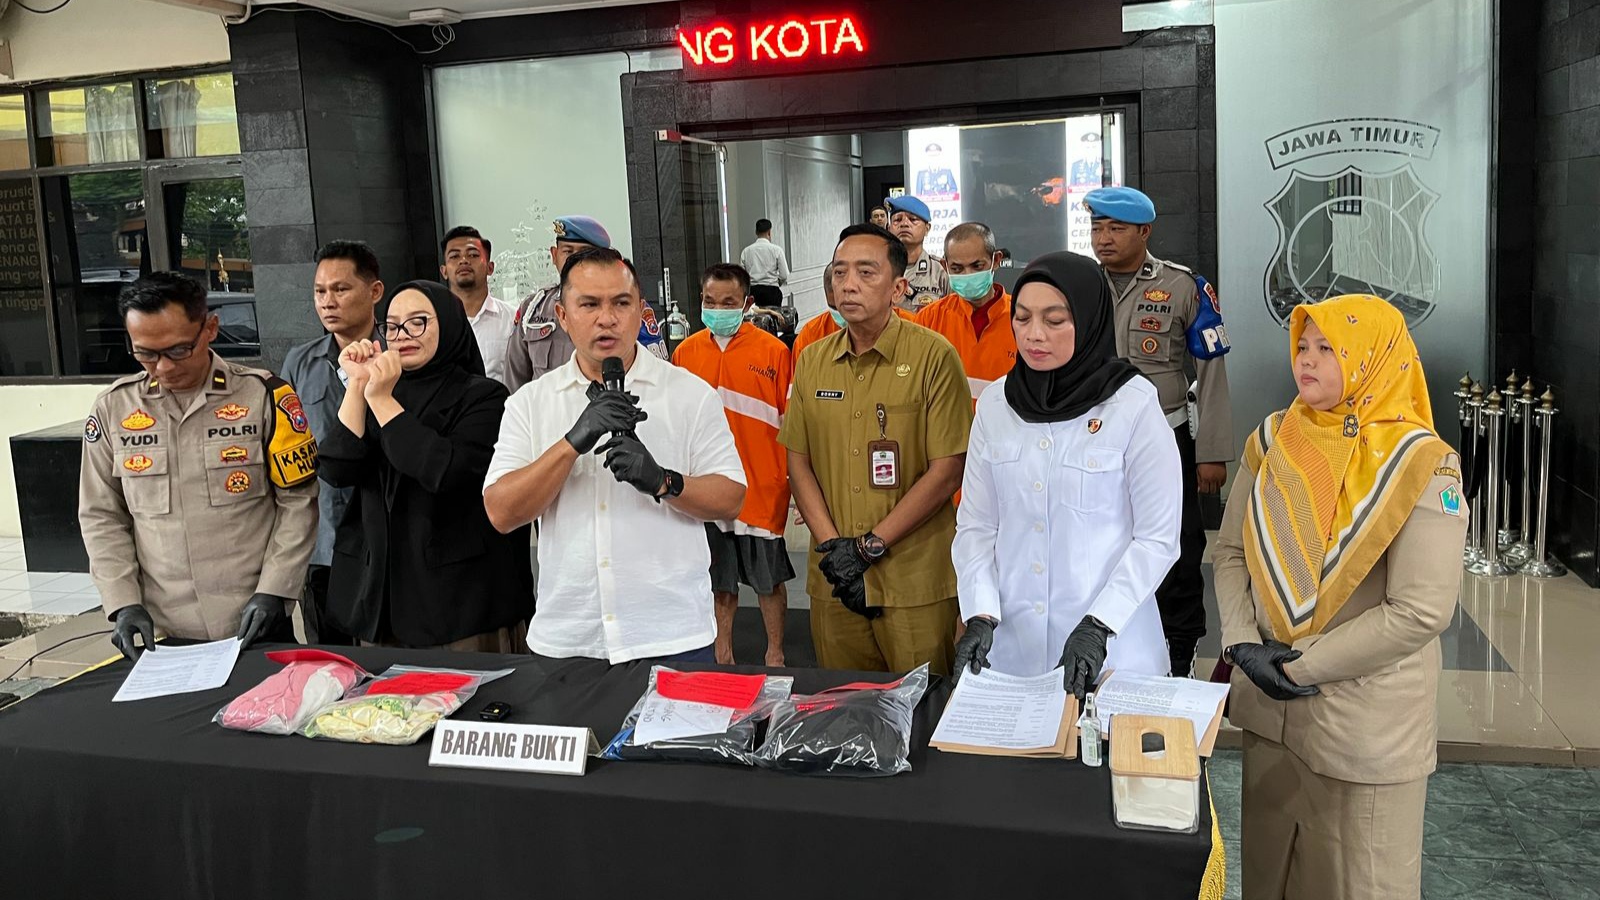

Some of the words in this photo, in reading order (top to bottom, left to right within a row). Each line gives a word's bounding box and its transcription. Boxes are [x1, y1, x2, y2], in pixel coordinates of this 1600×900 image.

[679, 27, 734, 65] NG
[750, 18, 863, 61] KOTA
[1278, 129, 1341, 156] JAWA
[1350, 127, 1425, 149] TIMUR
[1137, 304, 1171, 314] POLRI
[120, 434, 158, 446] YUDI
[208, 424, 257, 438] POLRI
[440, 729, 517, 758] BARANG
[520, 734, 577, 762] BUKTI
